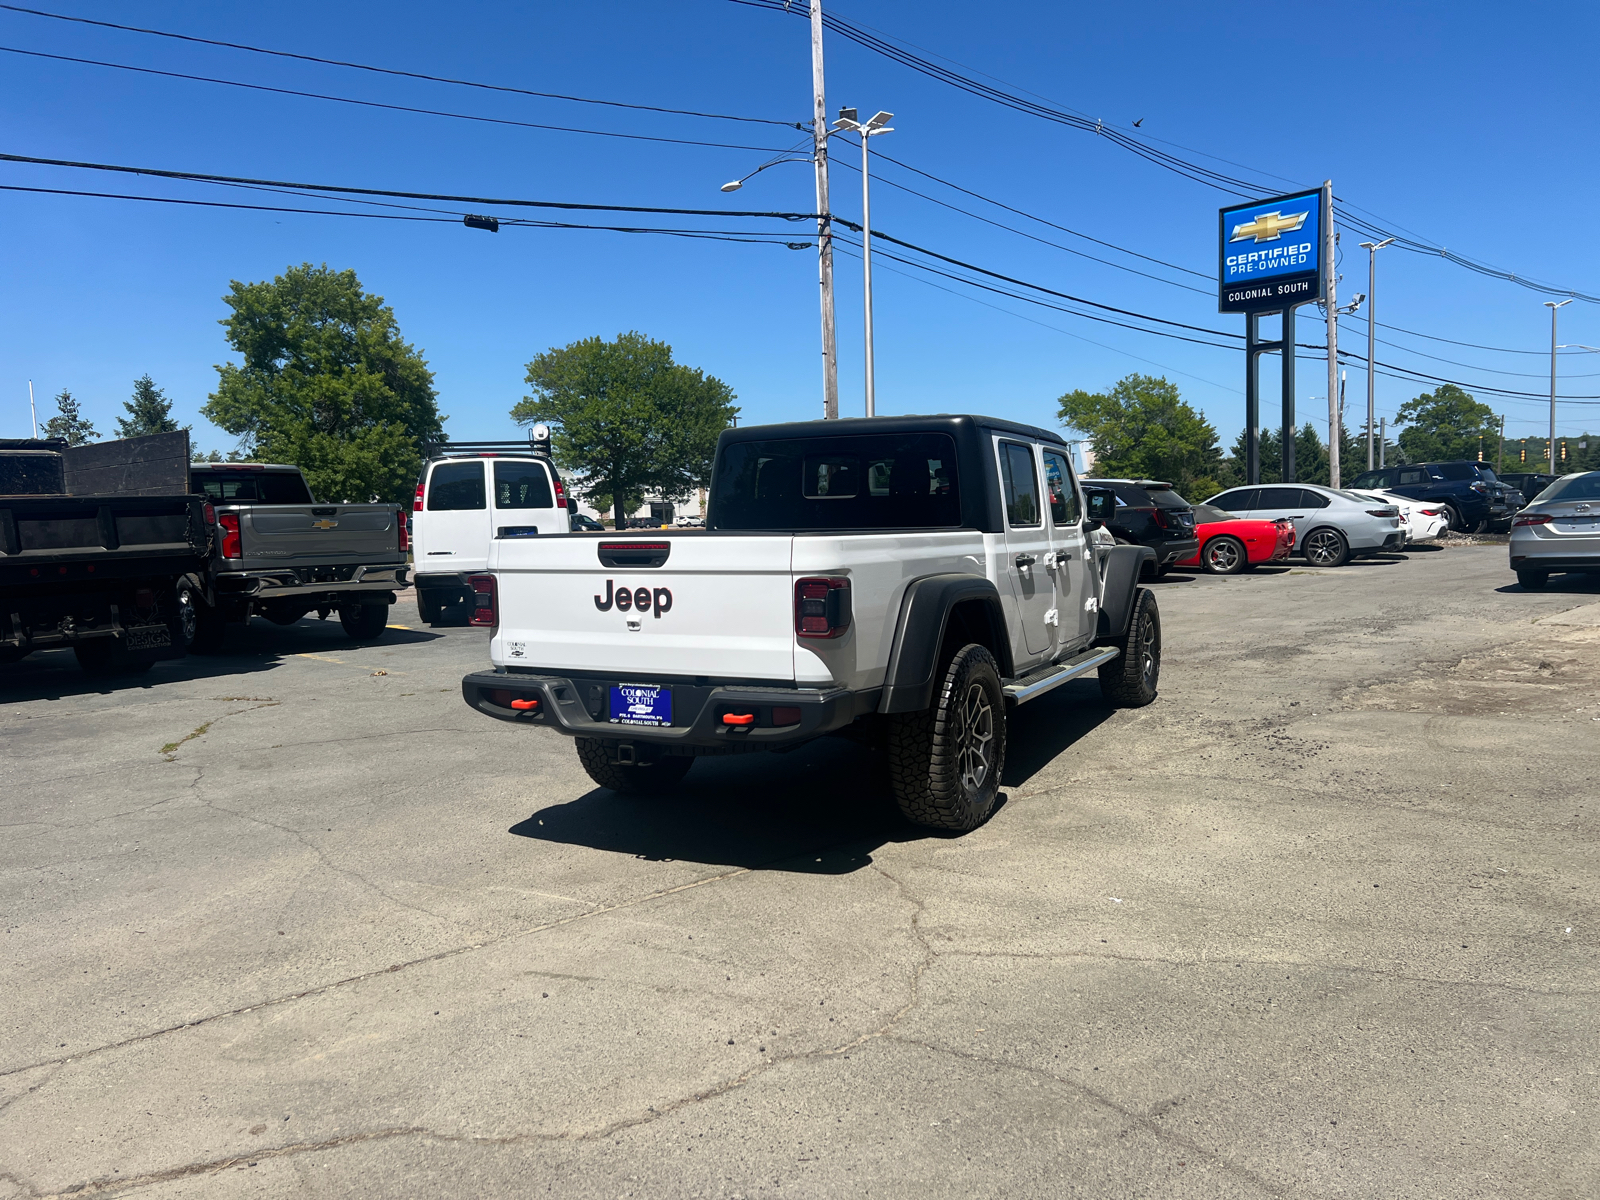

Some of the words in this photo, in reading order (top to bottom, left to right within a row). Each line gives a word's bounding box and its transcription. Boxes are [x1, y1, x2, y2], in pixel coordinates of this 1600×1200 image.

[1226, 242, 1311, 266] CERTIFIED
[1230, 254, 1307, 275] PRE-OWNED
[1228, 287, 1273, 302] COLONIAL
[1277, 281, 1309, 295] SOUTH
[594, 579, 673, 619] Jeep
[126, 632, 171, 646] DESIGN
[621, 688, 659, 698] COLONIAL
[627, 696, 653, 705] SOUTH
